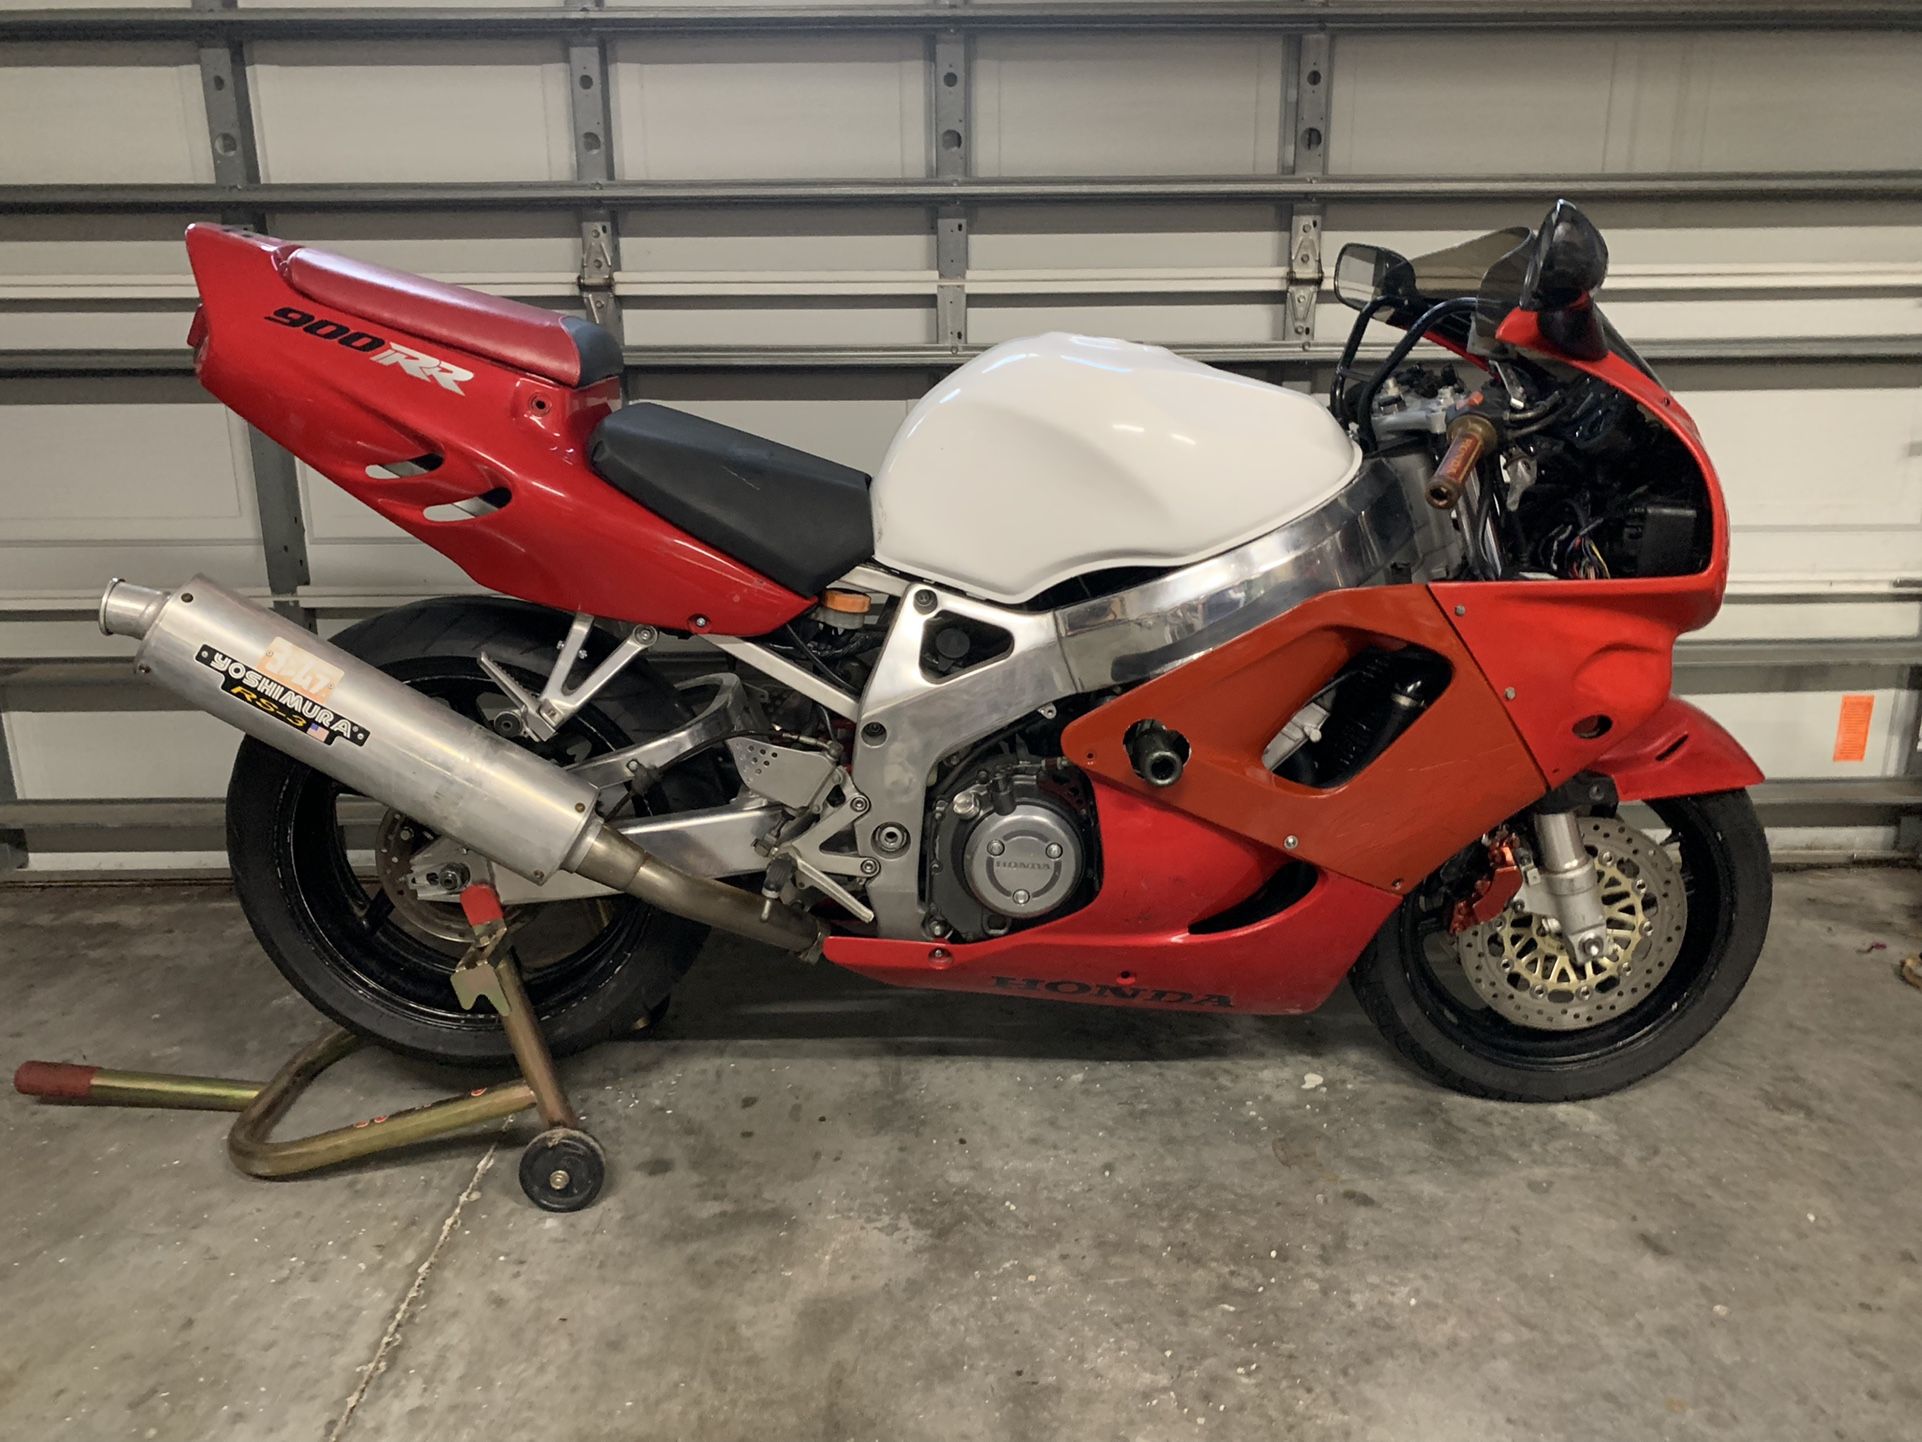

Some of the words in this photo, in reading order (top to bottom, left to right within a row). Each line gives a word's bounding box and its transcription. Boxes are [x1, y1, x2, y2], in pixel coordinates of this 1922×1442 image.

[210, 652, 351, 739] YOSHIMURA
[231, 685, 307, 727] RS-3
[996, 861, 1051, 870] HONDA
[991, 975, 1236, 1008] HONDA
